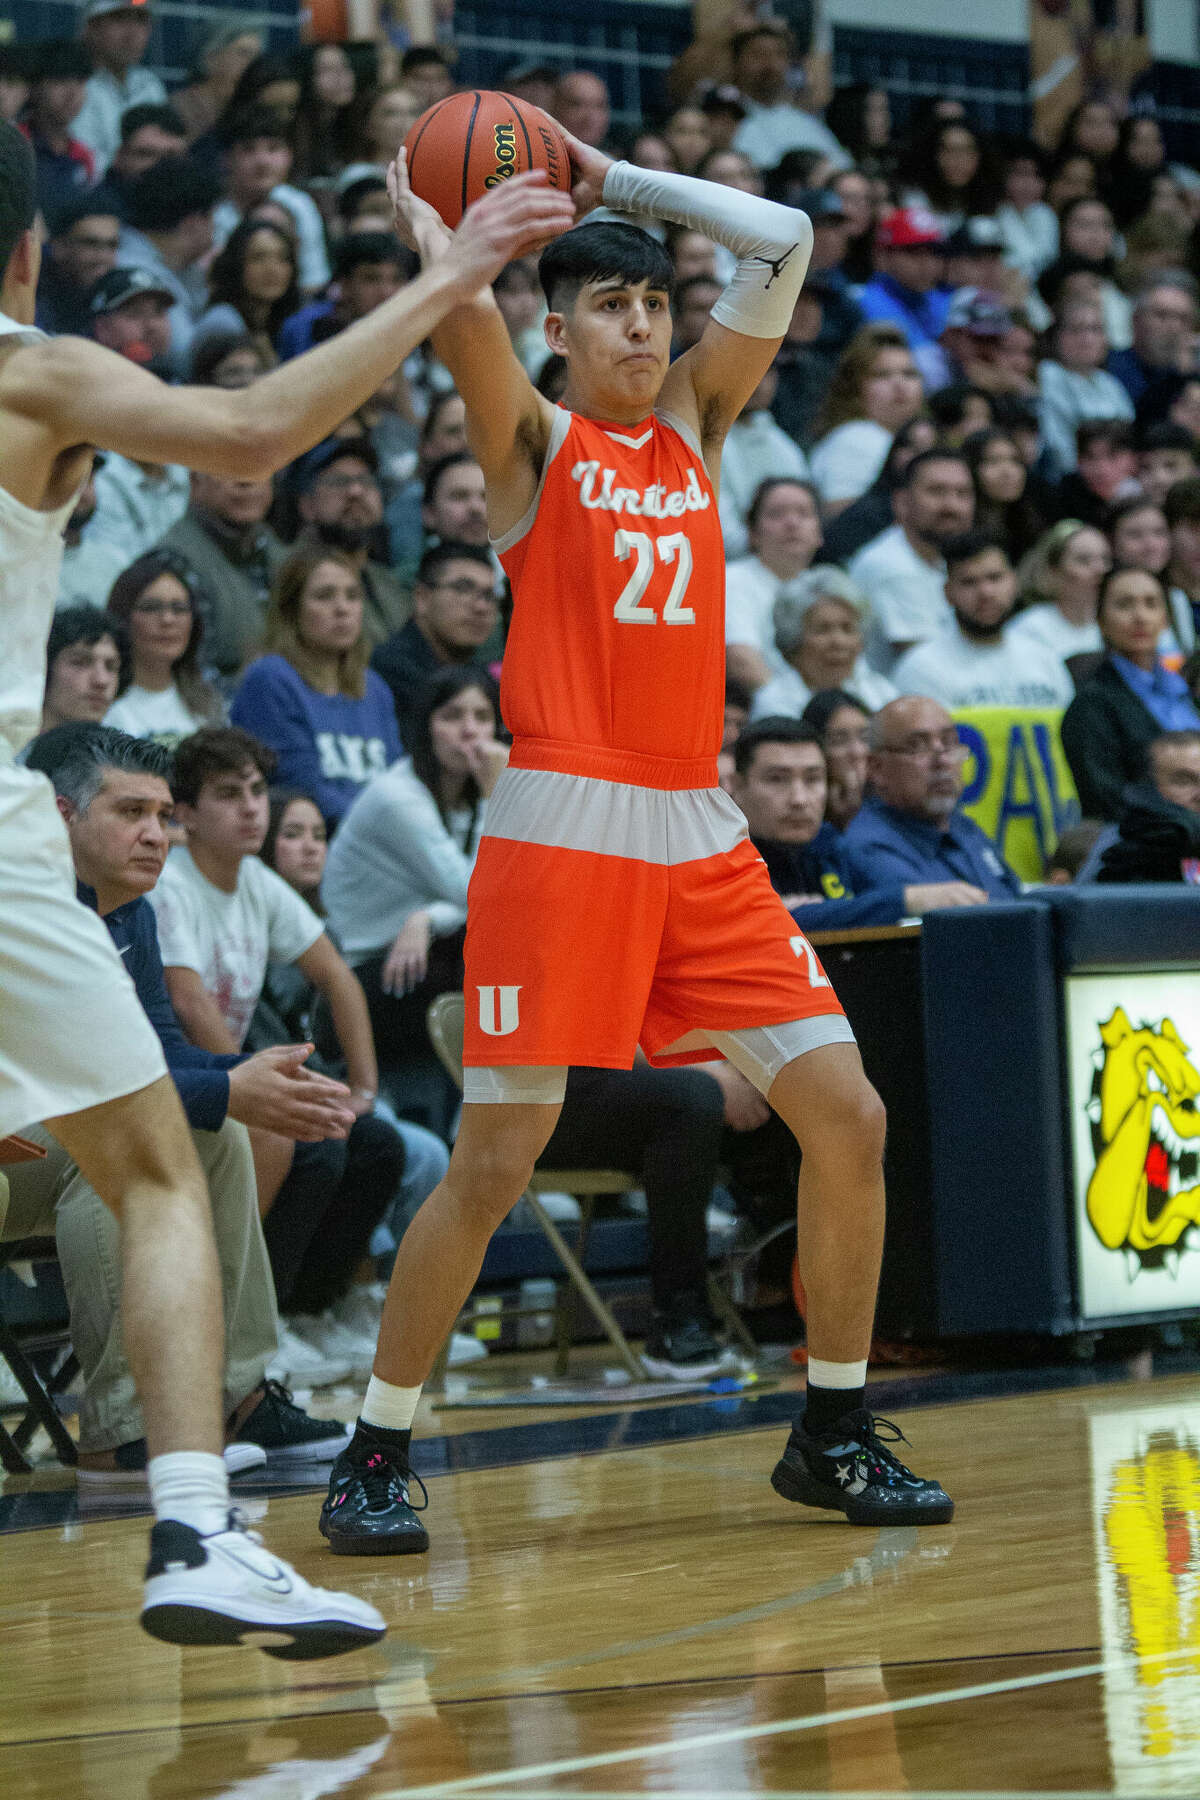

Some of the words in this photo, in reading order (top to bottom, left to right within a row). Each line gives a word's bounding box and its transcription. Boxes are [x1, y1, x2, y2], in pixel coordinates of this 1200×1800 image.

[571, 459, 711, 520] United
[613, 528, 696, 625] 22
[476, 985, 523, 1036] U
